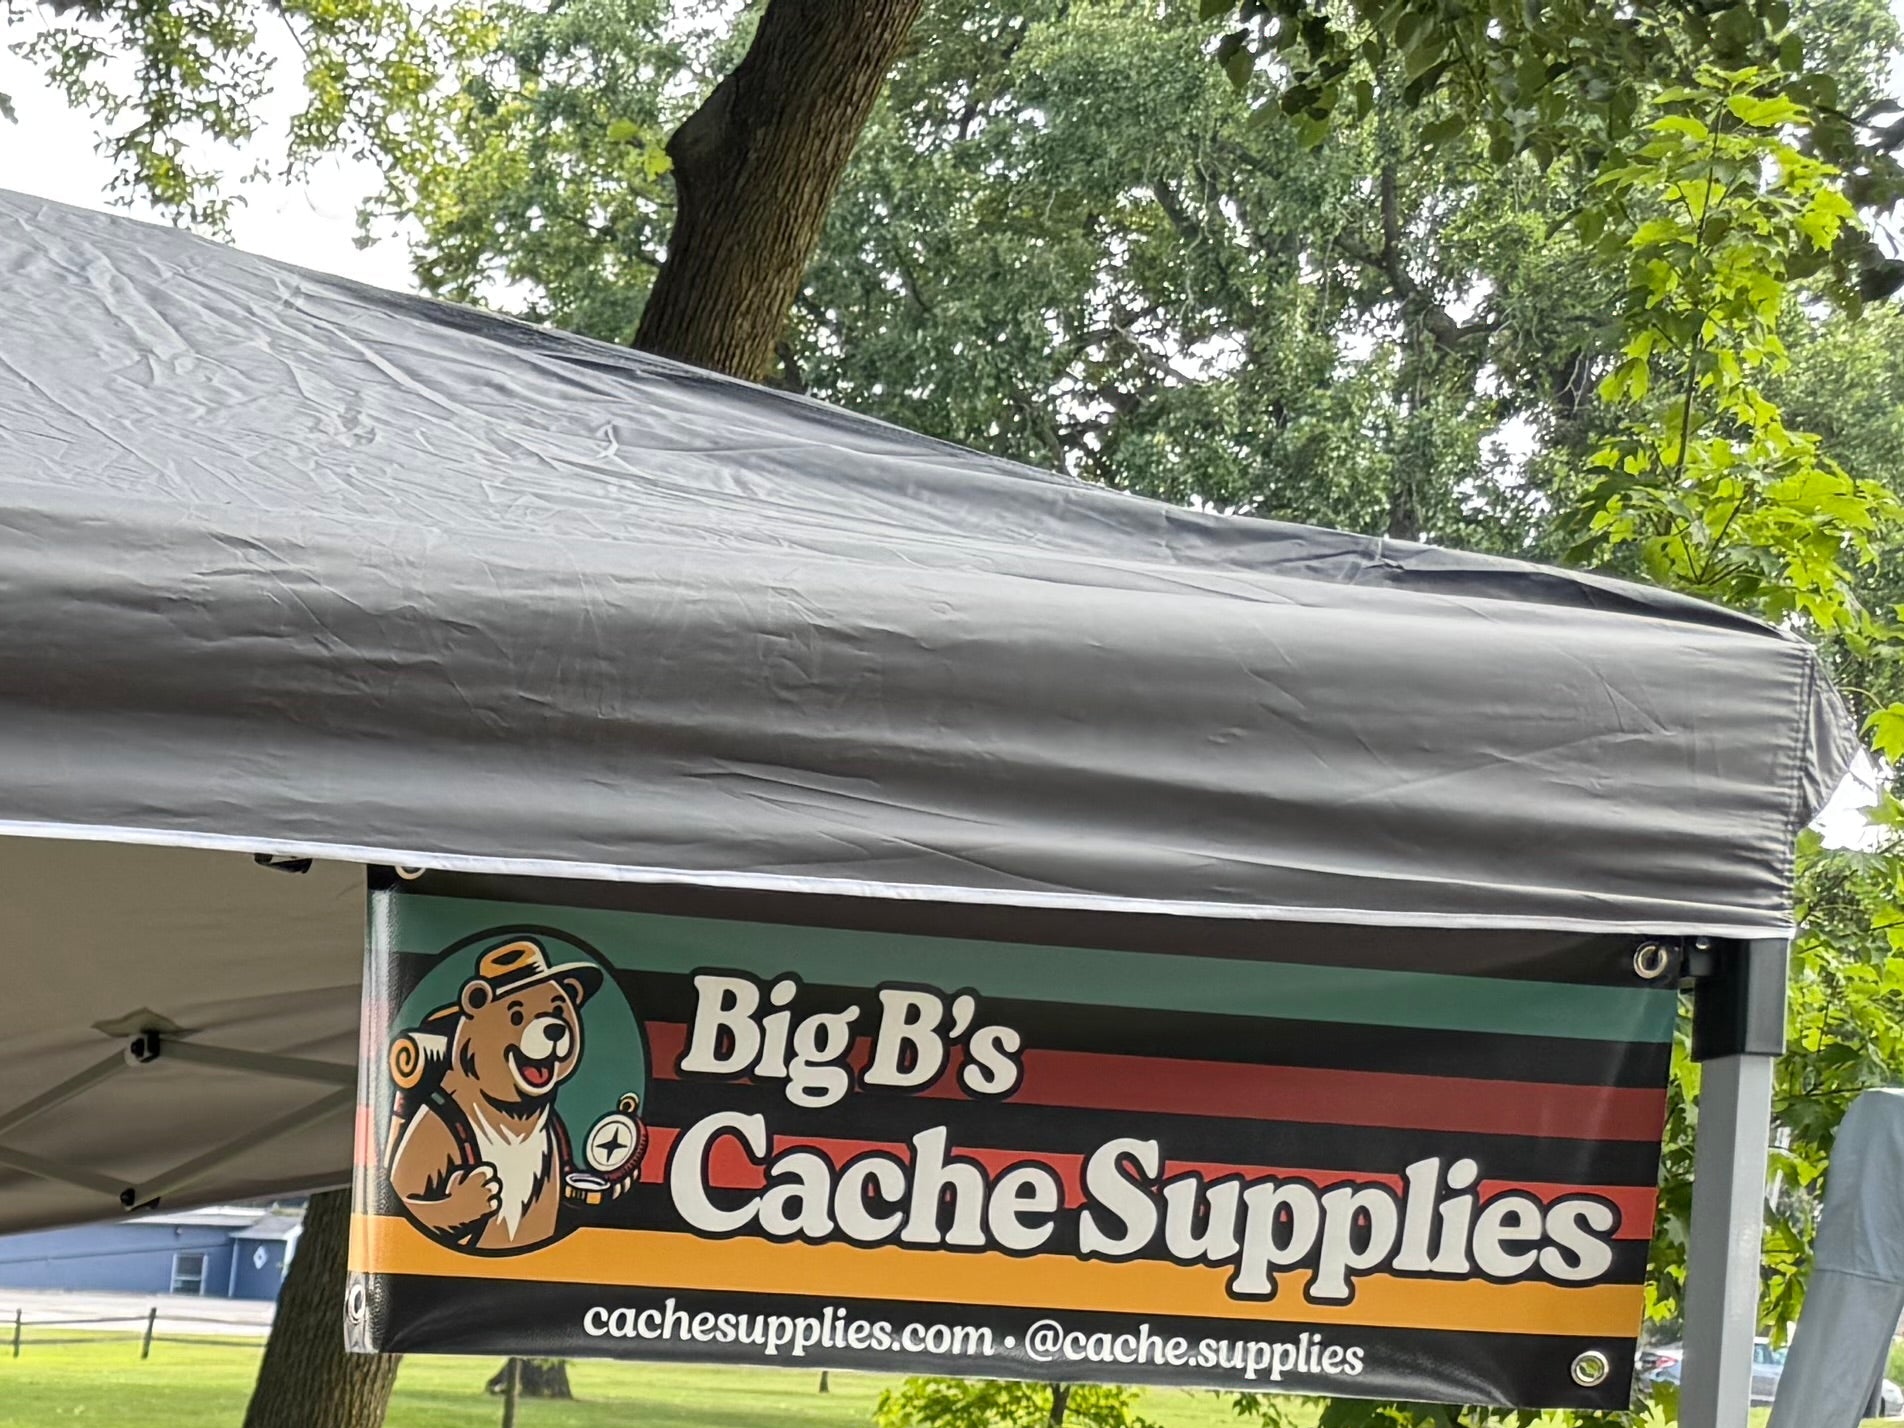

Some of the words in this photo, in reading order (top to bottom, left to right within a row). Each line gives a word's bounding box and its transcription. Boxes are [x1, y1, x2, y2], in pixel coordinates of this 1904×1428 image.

[678, 973, 859, 1107] Big
[862, 987, 1023, 1100] B's
[668, 1110, 1055, 1253] Cache
[1079, 1136, 1617, 1301] Supplies
[582, 1297, 993, 1359] cachesupplies.com
[1025, 1317, 1365, 1381] @cache.supplies
